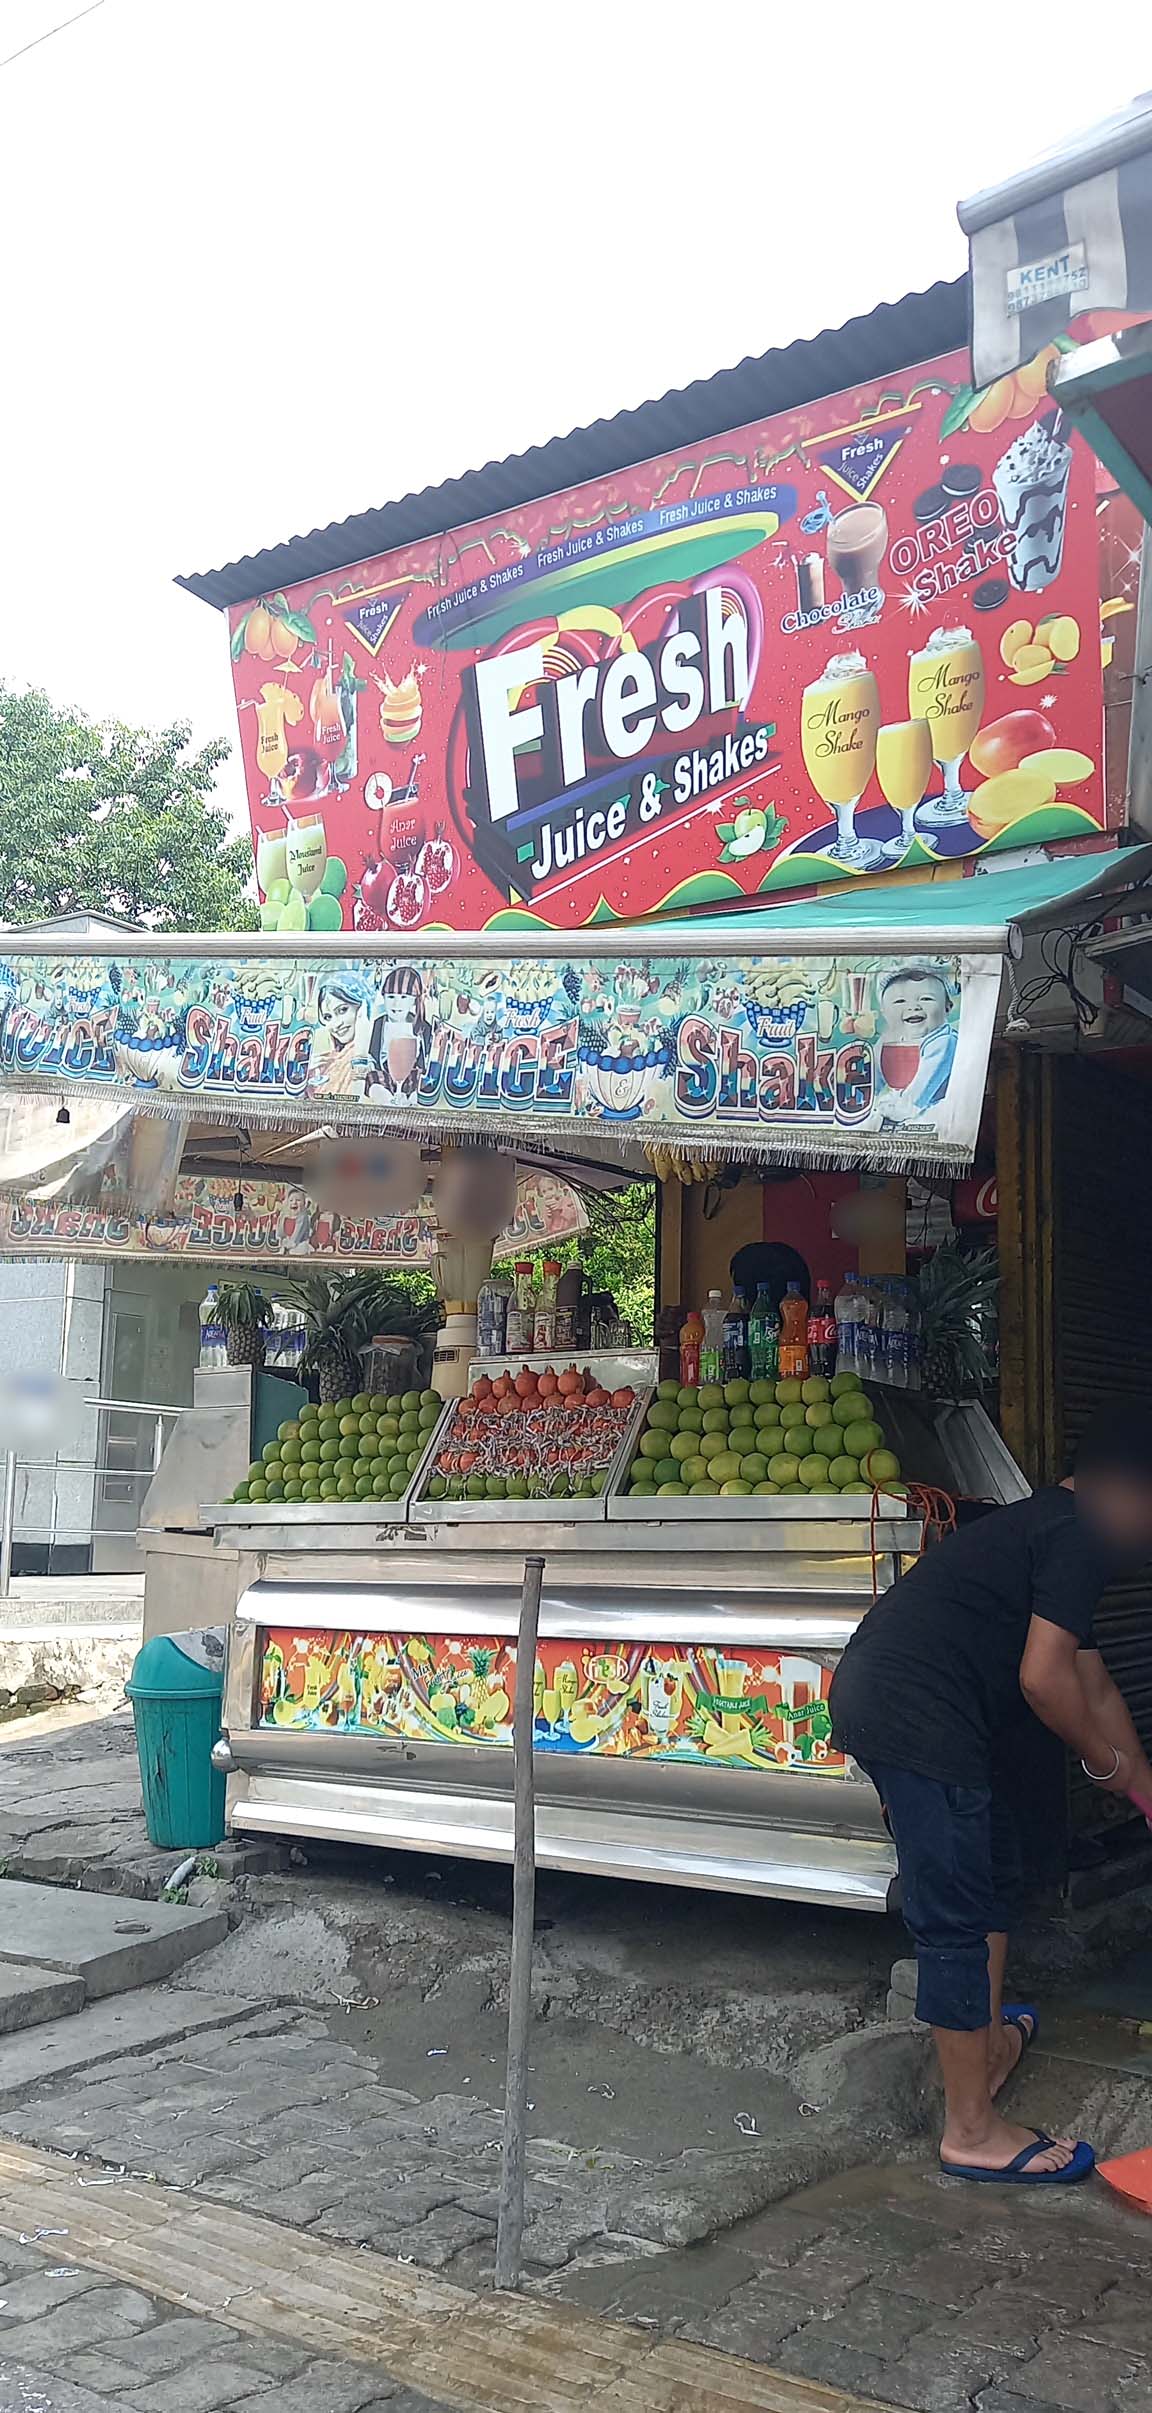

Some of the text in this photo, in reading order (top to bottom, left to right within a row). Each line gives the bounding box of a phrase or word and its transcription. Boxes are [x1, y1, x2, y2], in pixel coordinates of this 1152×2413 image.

[1020, 254, 1070, 285] KENT
[841, 438, 883, 461] Fresh
[838, 461, 860, 481] Juice
[660, 486, 777, 525] Fresh Juice & Shakes
[537, 519, 644, 568] Fresh Juice & Shakes
[890, 489, 1000, 575] OREO
[913, 531, 1018, 603] Shake
[427, 564, 524, 620] Fresh Juice & Shakes
[360, 602, 388, 619] Fresh
[781, 586, 880, 633] Chocolate
[917, 663, 980, 693] Mango
[474, 585, 749, 822] Fresh
[807, 698, 870, 730] Mango
[925, 690, 974, 719] Shake
[261, 732, 279, 745] Fresh
[322, 723, 341, 735] Fresh
[323, 734, 341, 744] Juice
[815, 728, 864, 758] Shake
[261, 743, 279, 754] Juice
[531, 727, 769, 880] Juice & Shakes
[390, 835, 417, 851] Juice
[297, 863, 316, 877] Juice
[503, 1007, 541, 1029] Fresh
[756, 1015, 797, 1039] Fruit
[178, 1004, 314, 1095] Shake
[417, 1014, 580, 1113] JUICE
[674, 1013, 876, 1127] Shake
[615, 1078, 630, 1097] &
[411, 1664, 431, 1680] Mix
[787, 1703, 824, 1720] Anar Juice
